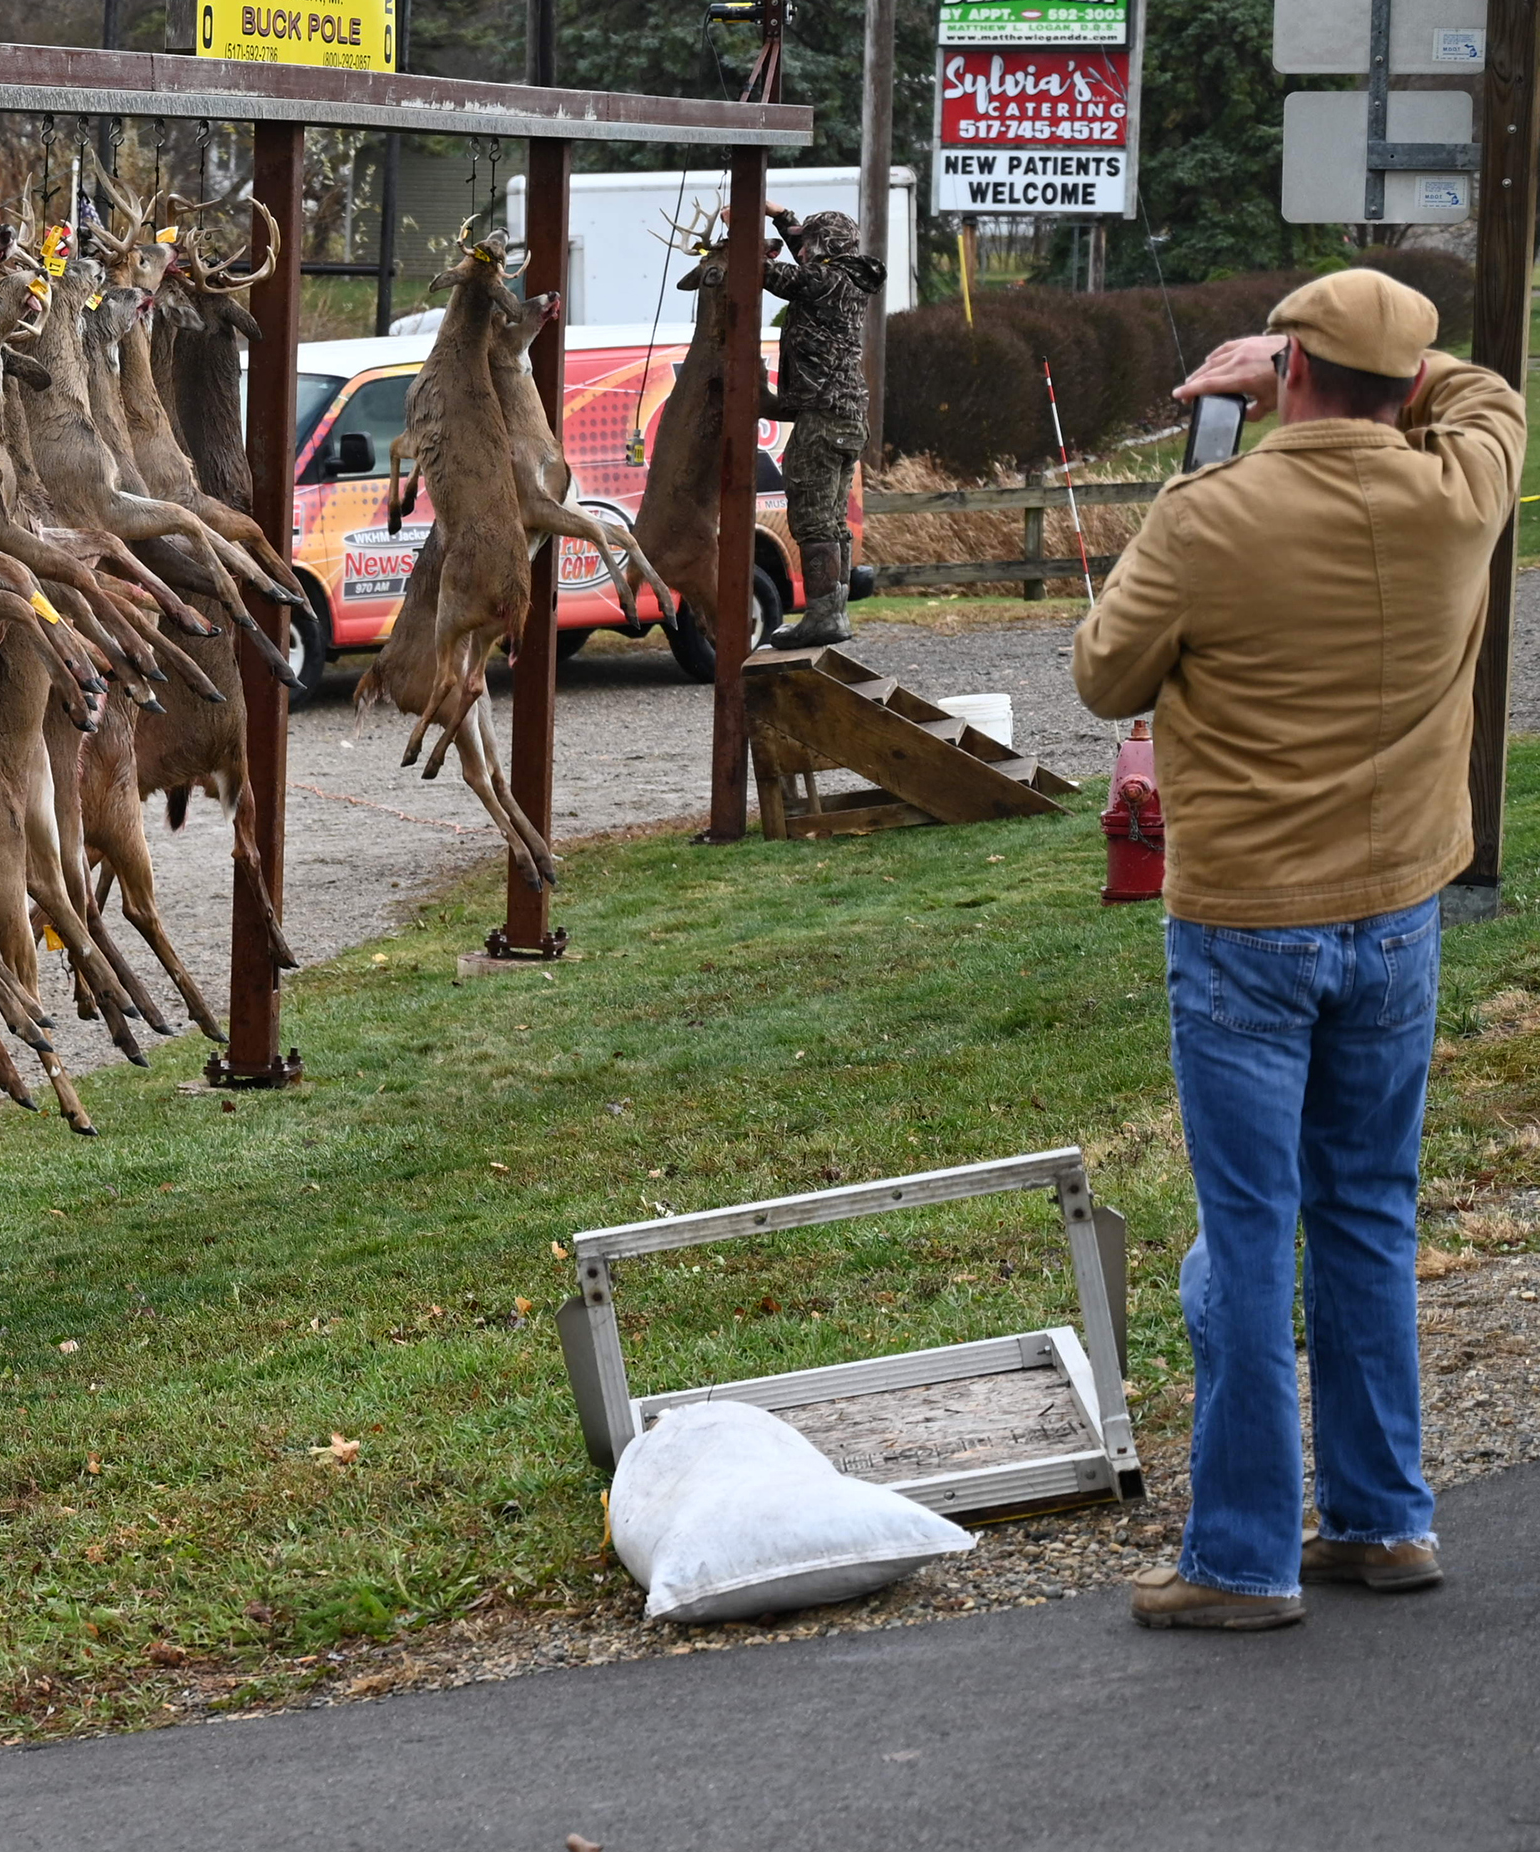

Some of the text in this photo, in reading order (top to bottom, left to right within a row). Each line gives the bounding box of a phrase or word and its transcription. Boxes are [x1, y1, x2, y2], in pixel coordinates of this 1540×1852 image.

[242, 6, 361, 45] BUCK POLE
[940, 9, 1125, 21] BY APPT. 592-3003
[947, 24, 1007, 32] MATTHEW
[944, 55, 1097, 115] Sylvia's
[987, 102, 1127, 118] CATERING
[958, 119, 1119, 140] 517-745-4512
[944, 155, 1121, 177] NEW PATIENTS
[968, 181, 1097, 206] WELCOME
[353, 531, 390, 544] WKHM
[561, 556, 600, 580] COW
[355, 581, 390, 594] 970 AM
